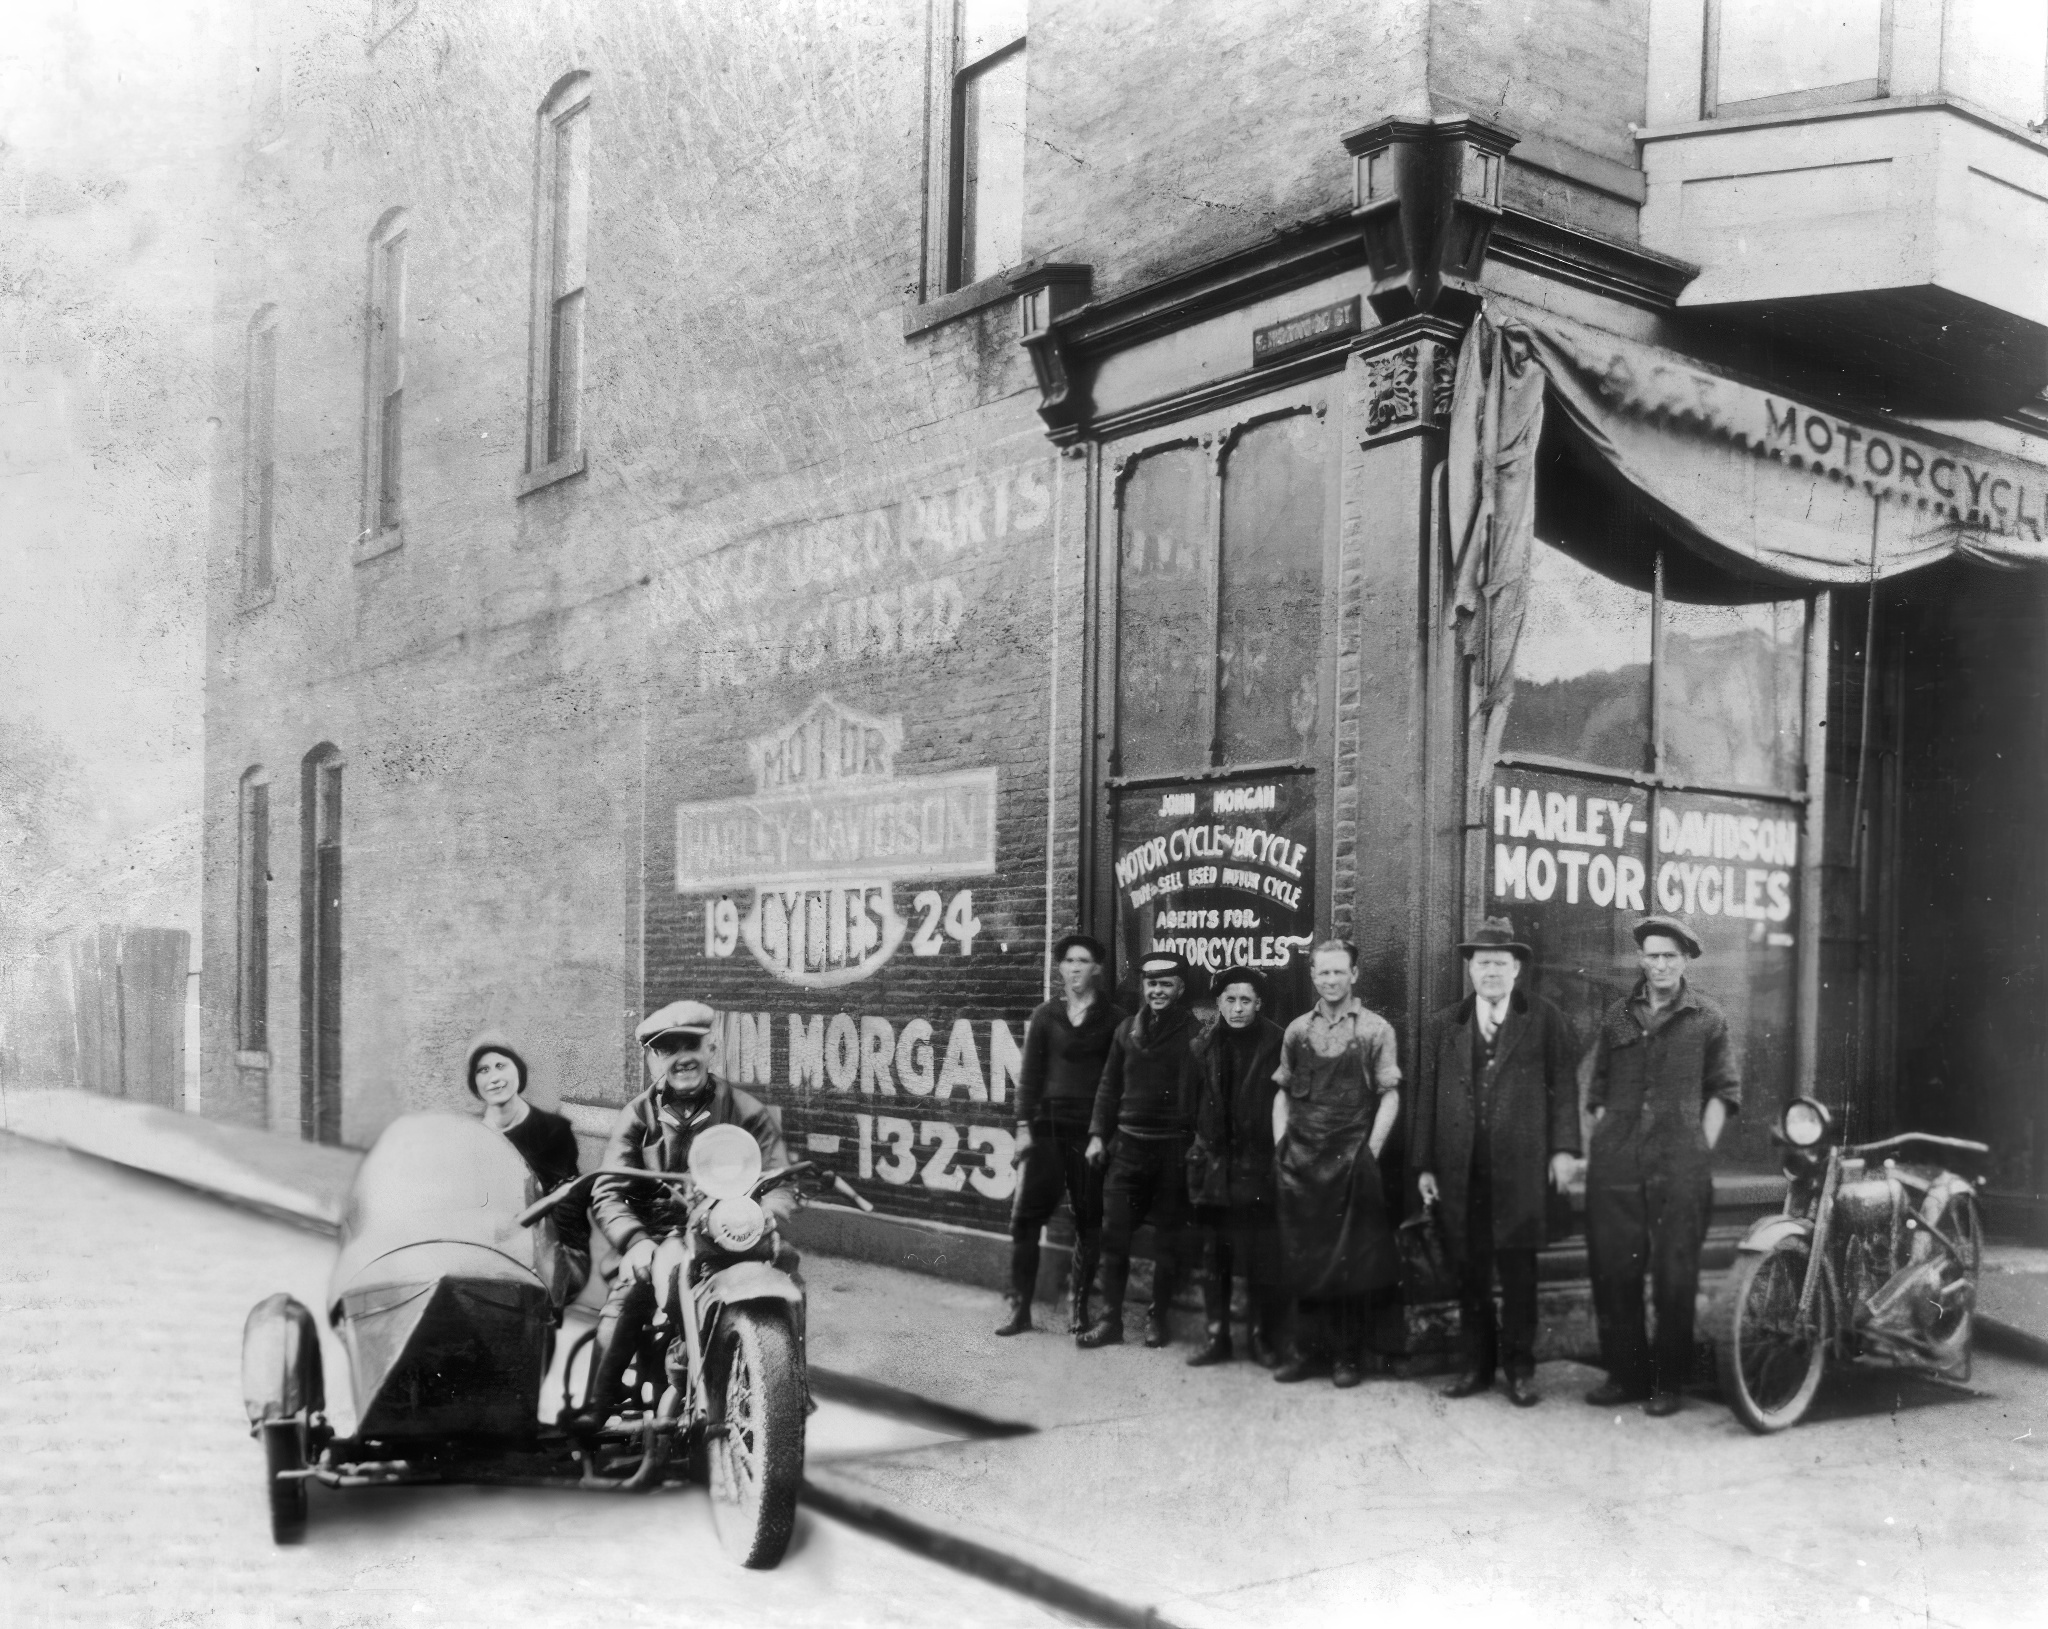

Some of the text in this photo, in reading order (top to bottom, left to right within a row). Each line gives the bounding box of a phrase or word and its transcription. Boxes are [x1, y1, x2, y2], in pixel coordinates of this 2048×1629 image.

[1765, 398, 2048, 538] MOTORCYCL
[762, 703, 888, 790] MOTOR
[1159, 786, 1276, 817] JOHN MORGAN
[1658, 807, 1797, 867] DAVIDSON
[1115, 836, 1170, 888] MOTOR
[1231, 825, 1308, 878] BICYCLE
[1188, 866, 1218, 887] USED
[1263, 875, 1302, 910] CYCLE
[1494, 843, 1791, 922] MOTOR CYCLES
[704, 886, 981, 974] 19 CYCLES 24
[1156, 909, 1260, 930] AGENTS FOR
[789, 1013, 1022, 1102] MORGAN
